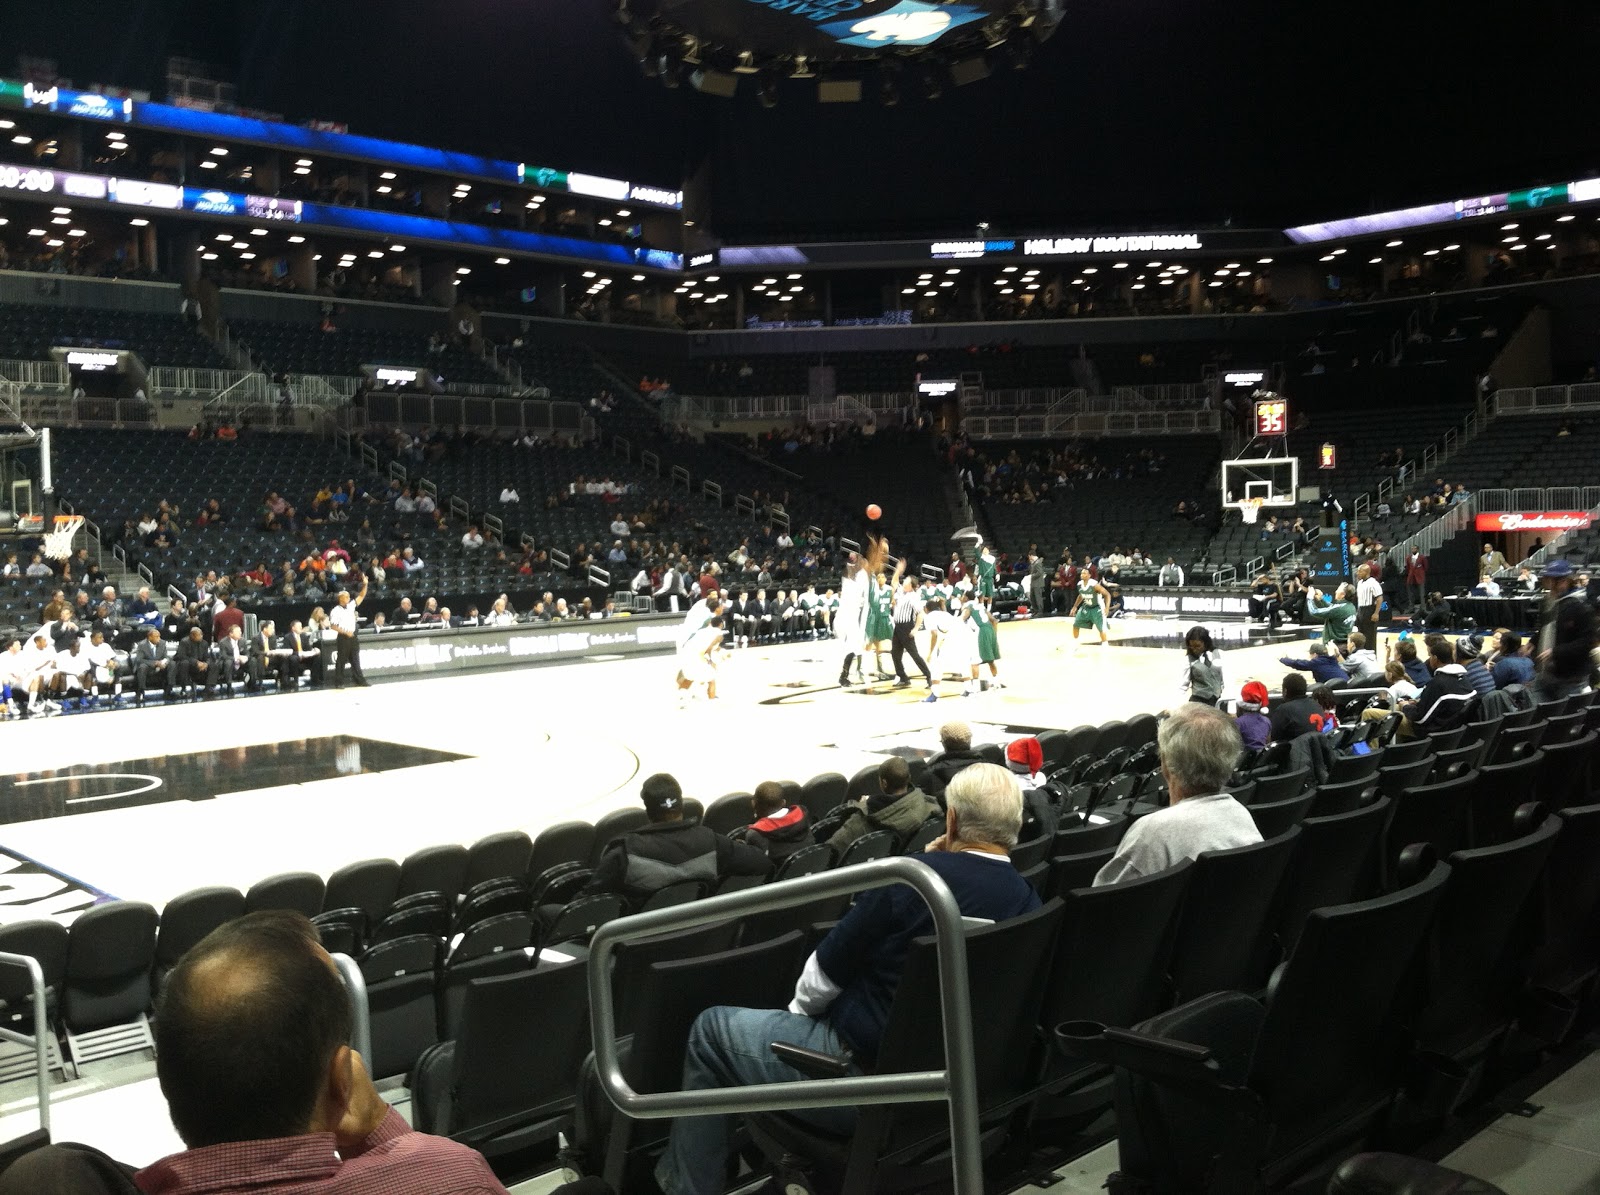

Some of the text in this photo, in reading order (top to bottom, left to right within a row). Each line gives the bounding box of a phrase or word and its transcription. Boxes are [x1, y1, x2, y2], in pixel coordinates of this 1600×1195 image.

[1024, 238, 1092, 254] HOLIDAY
[1262, 414, 1282, 431] 35
[1498, 513, 1588, 530] Budweiser
[1341, 531, 1349, 577] BARCLAYS
